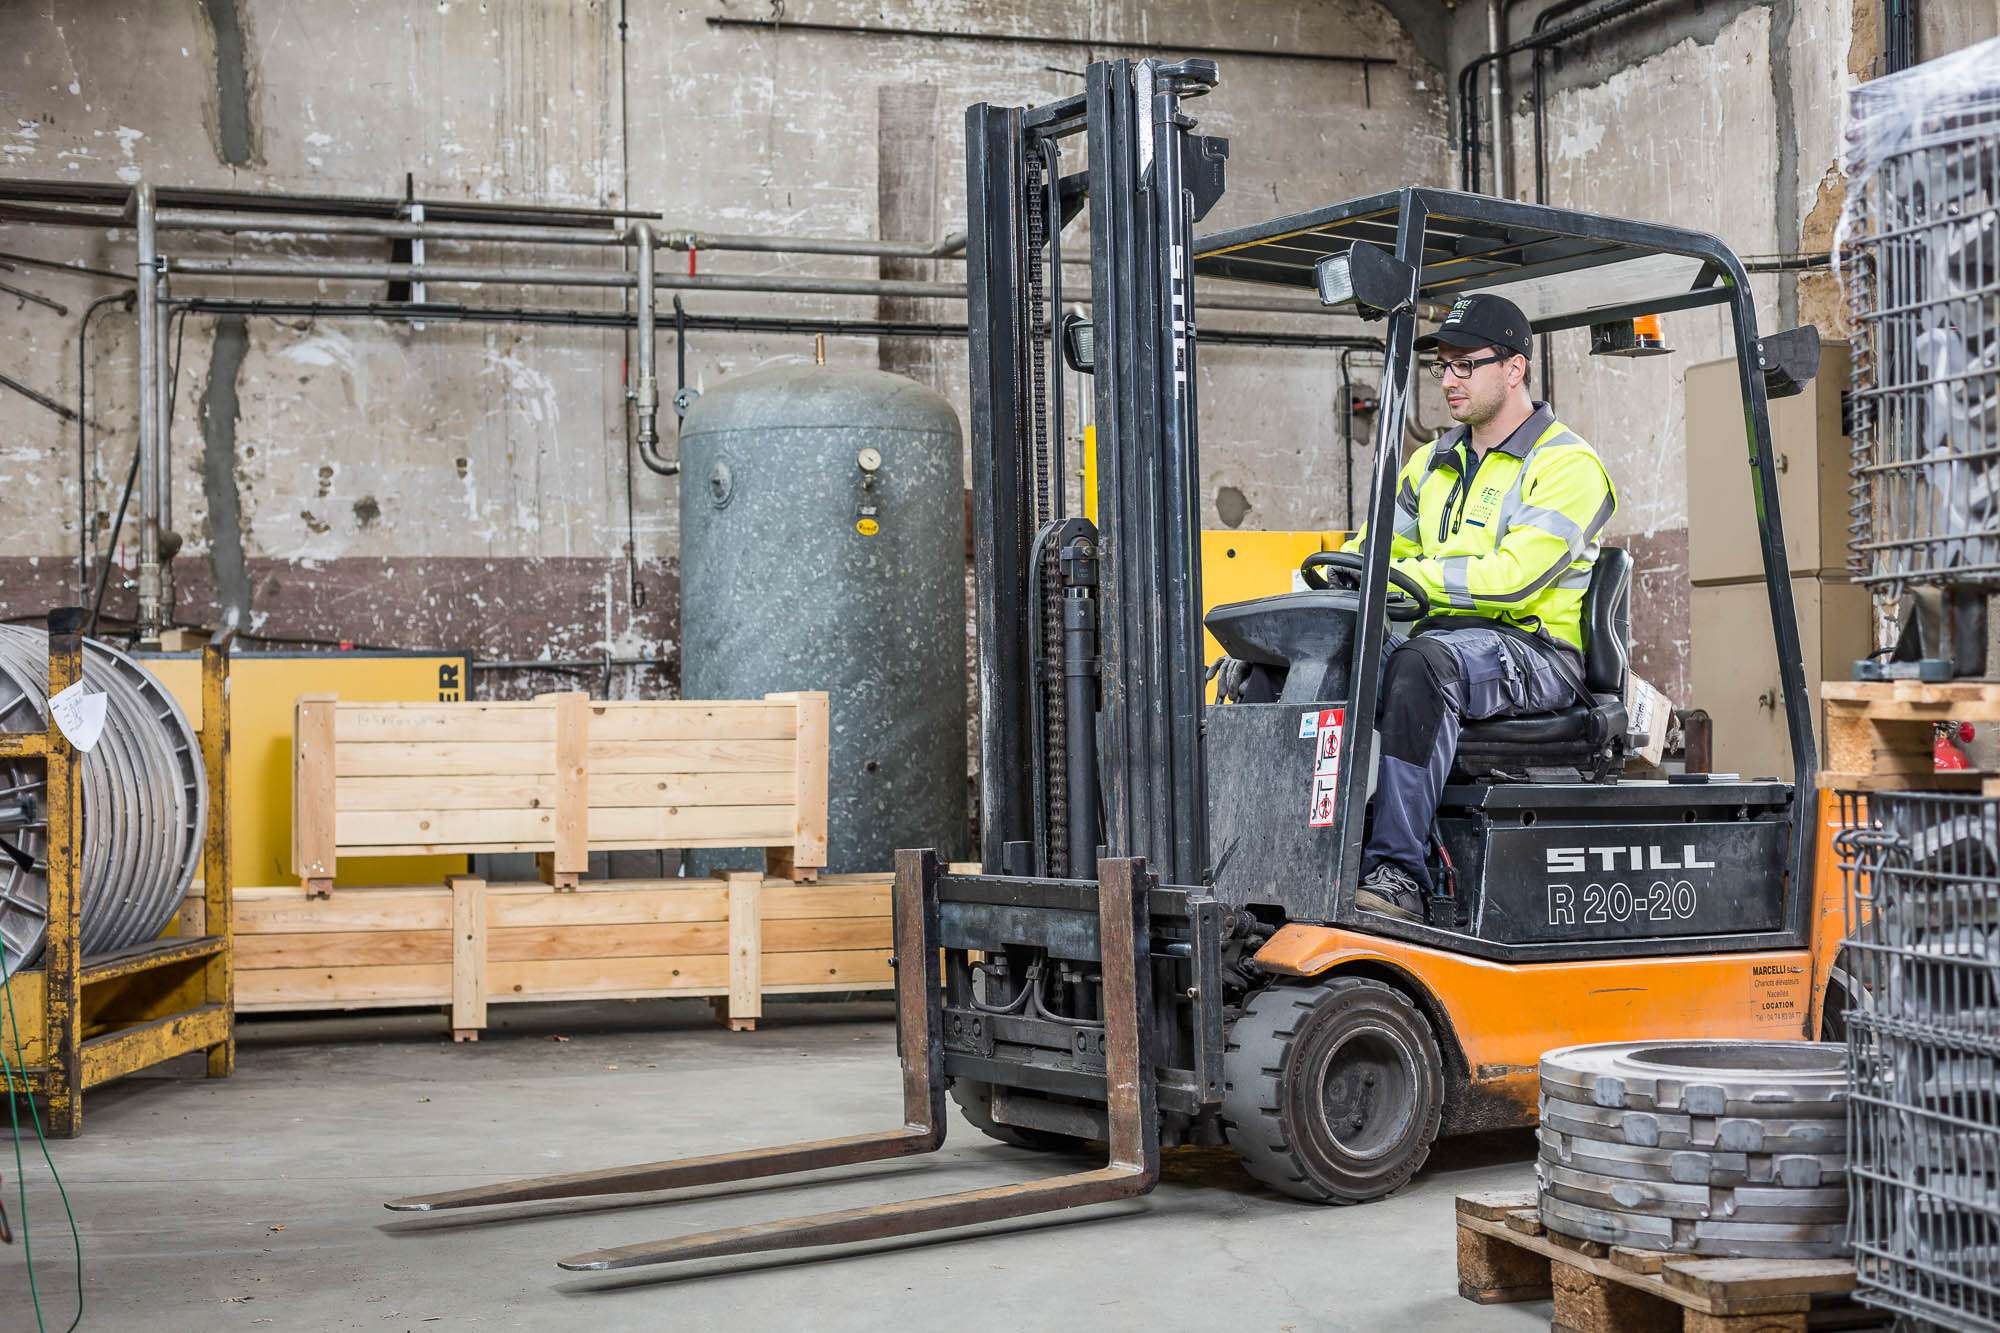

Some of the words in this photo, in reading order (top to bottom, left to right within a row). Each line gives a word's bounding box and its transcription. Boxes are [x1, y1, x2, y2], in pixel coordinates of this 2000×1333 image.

[1170, 244, 1187, 400] STILL
[1546, 844, 1716, 873] STILL
[1547, 884, 1576, 925] R
[1583, 880, 1697, 924] 20-20
[1752, 965, 1786, 976] MARCELLI
[1786, 966, 1800, 974] SA
[1762, 1000, 1794, 1010] LOCATION
